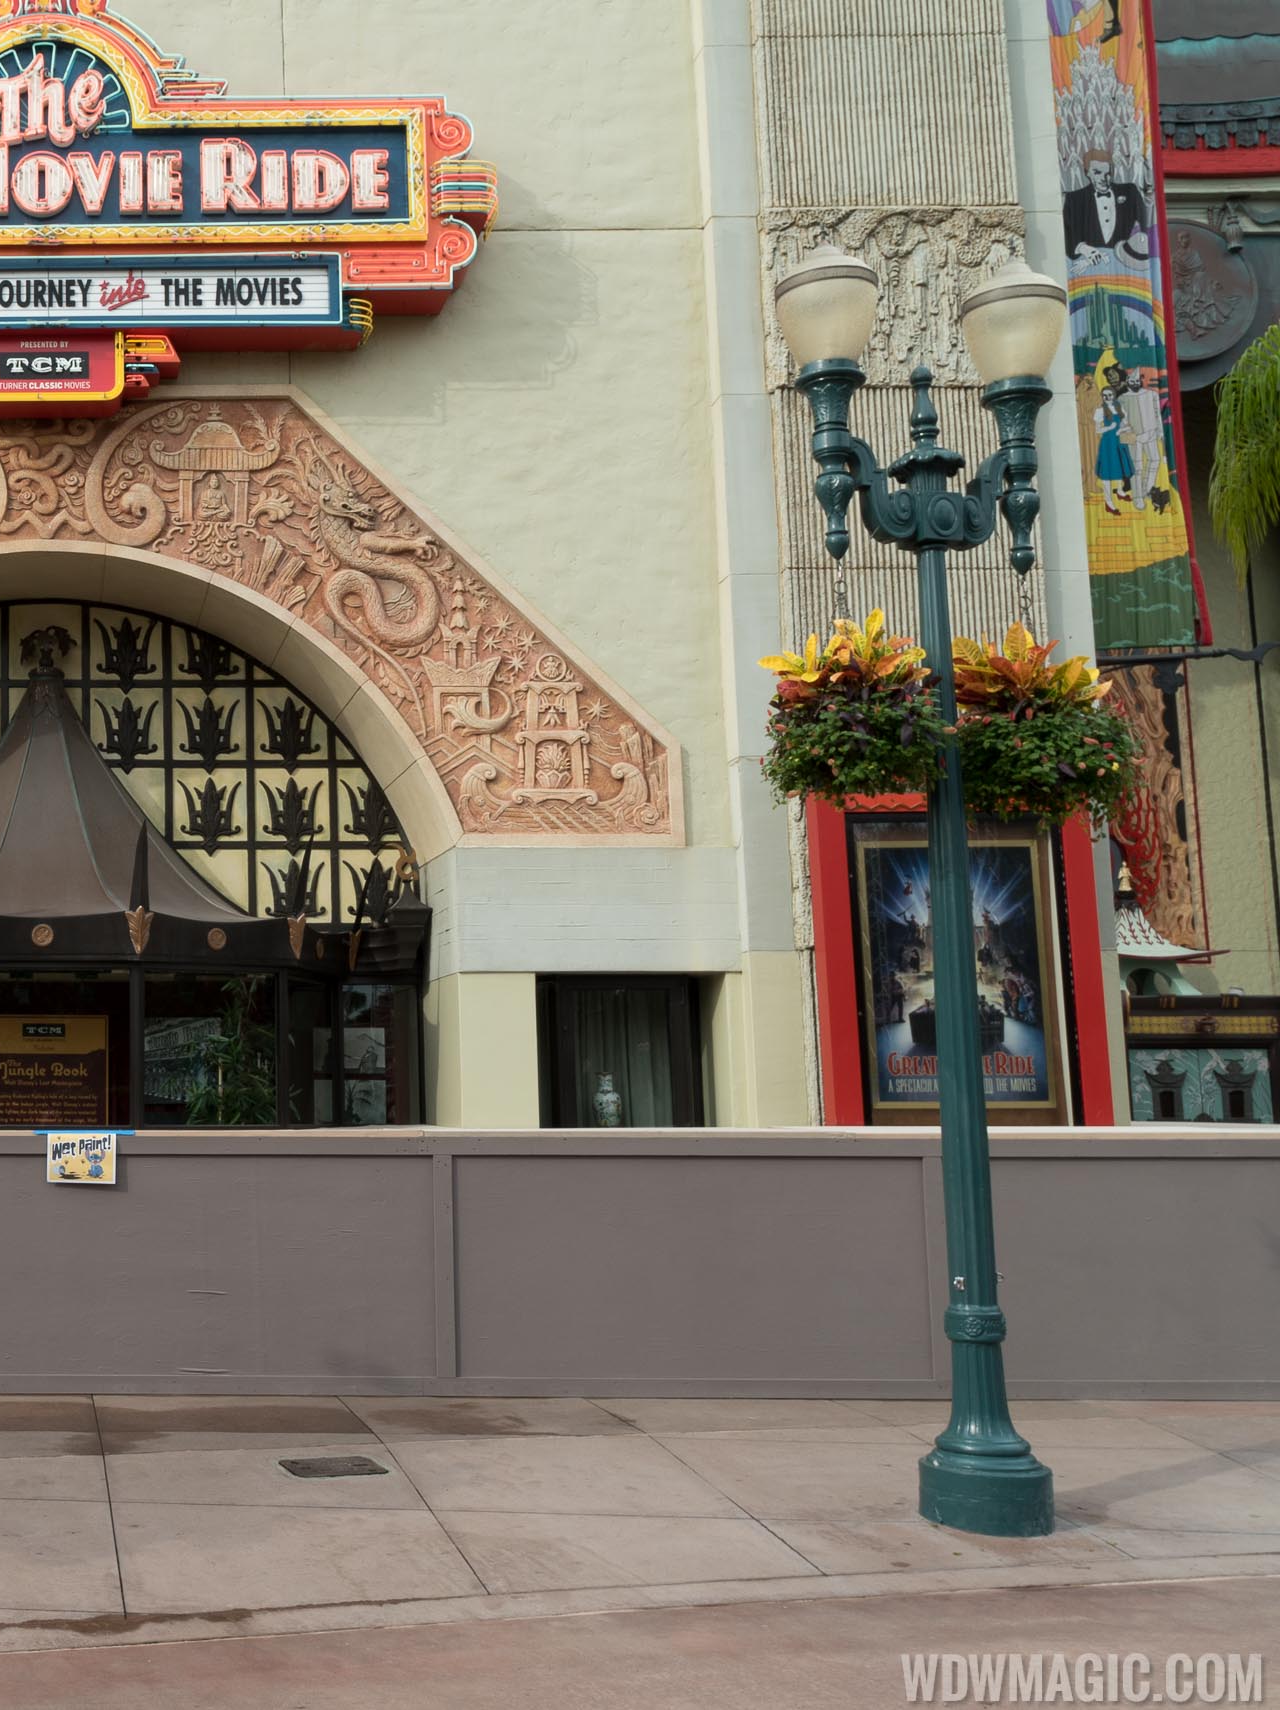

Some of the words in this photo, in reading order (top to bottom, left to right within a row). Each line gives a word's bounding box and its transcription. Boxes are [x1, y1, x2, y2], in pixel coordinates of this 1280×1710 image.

[200, 137, 389, 213] RIDE
[98, 268, 150, 311] into
[161, 278, 203, 307] THE
[215, 277, 303, 306] MOVIES
[20, 341, 58, 349] PRESENTED
[60, 341, 69, 349] BY
[5, 356, 83, 373] TCM
[28, 381, 63, 389] CLASSIC
[64, 381, 91, 389] MOVIES
[25, 1026, 63, 1034] TCM
[0, 1062, 46, 1080] Jungle
[50, 1062, 88, 1077] Book
[887, 1051, 938, 1076] GREAT
[993, 1051, 1035, 1076] RIDE
[888, 1078, 894, 1093] A
[895, 1078, 939, 1093] SPECTACULA
[996, 1078, 1008, 1092] THE
[1010, 1078, 1037, 1092] MOVIES
[52, 1142, 76, 1161] Wet
